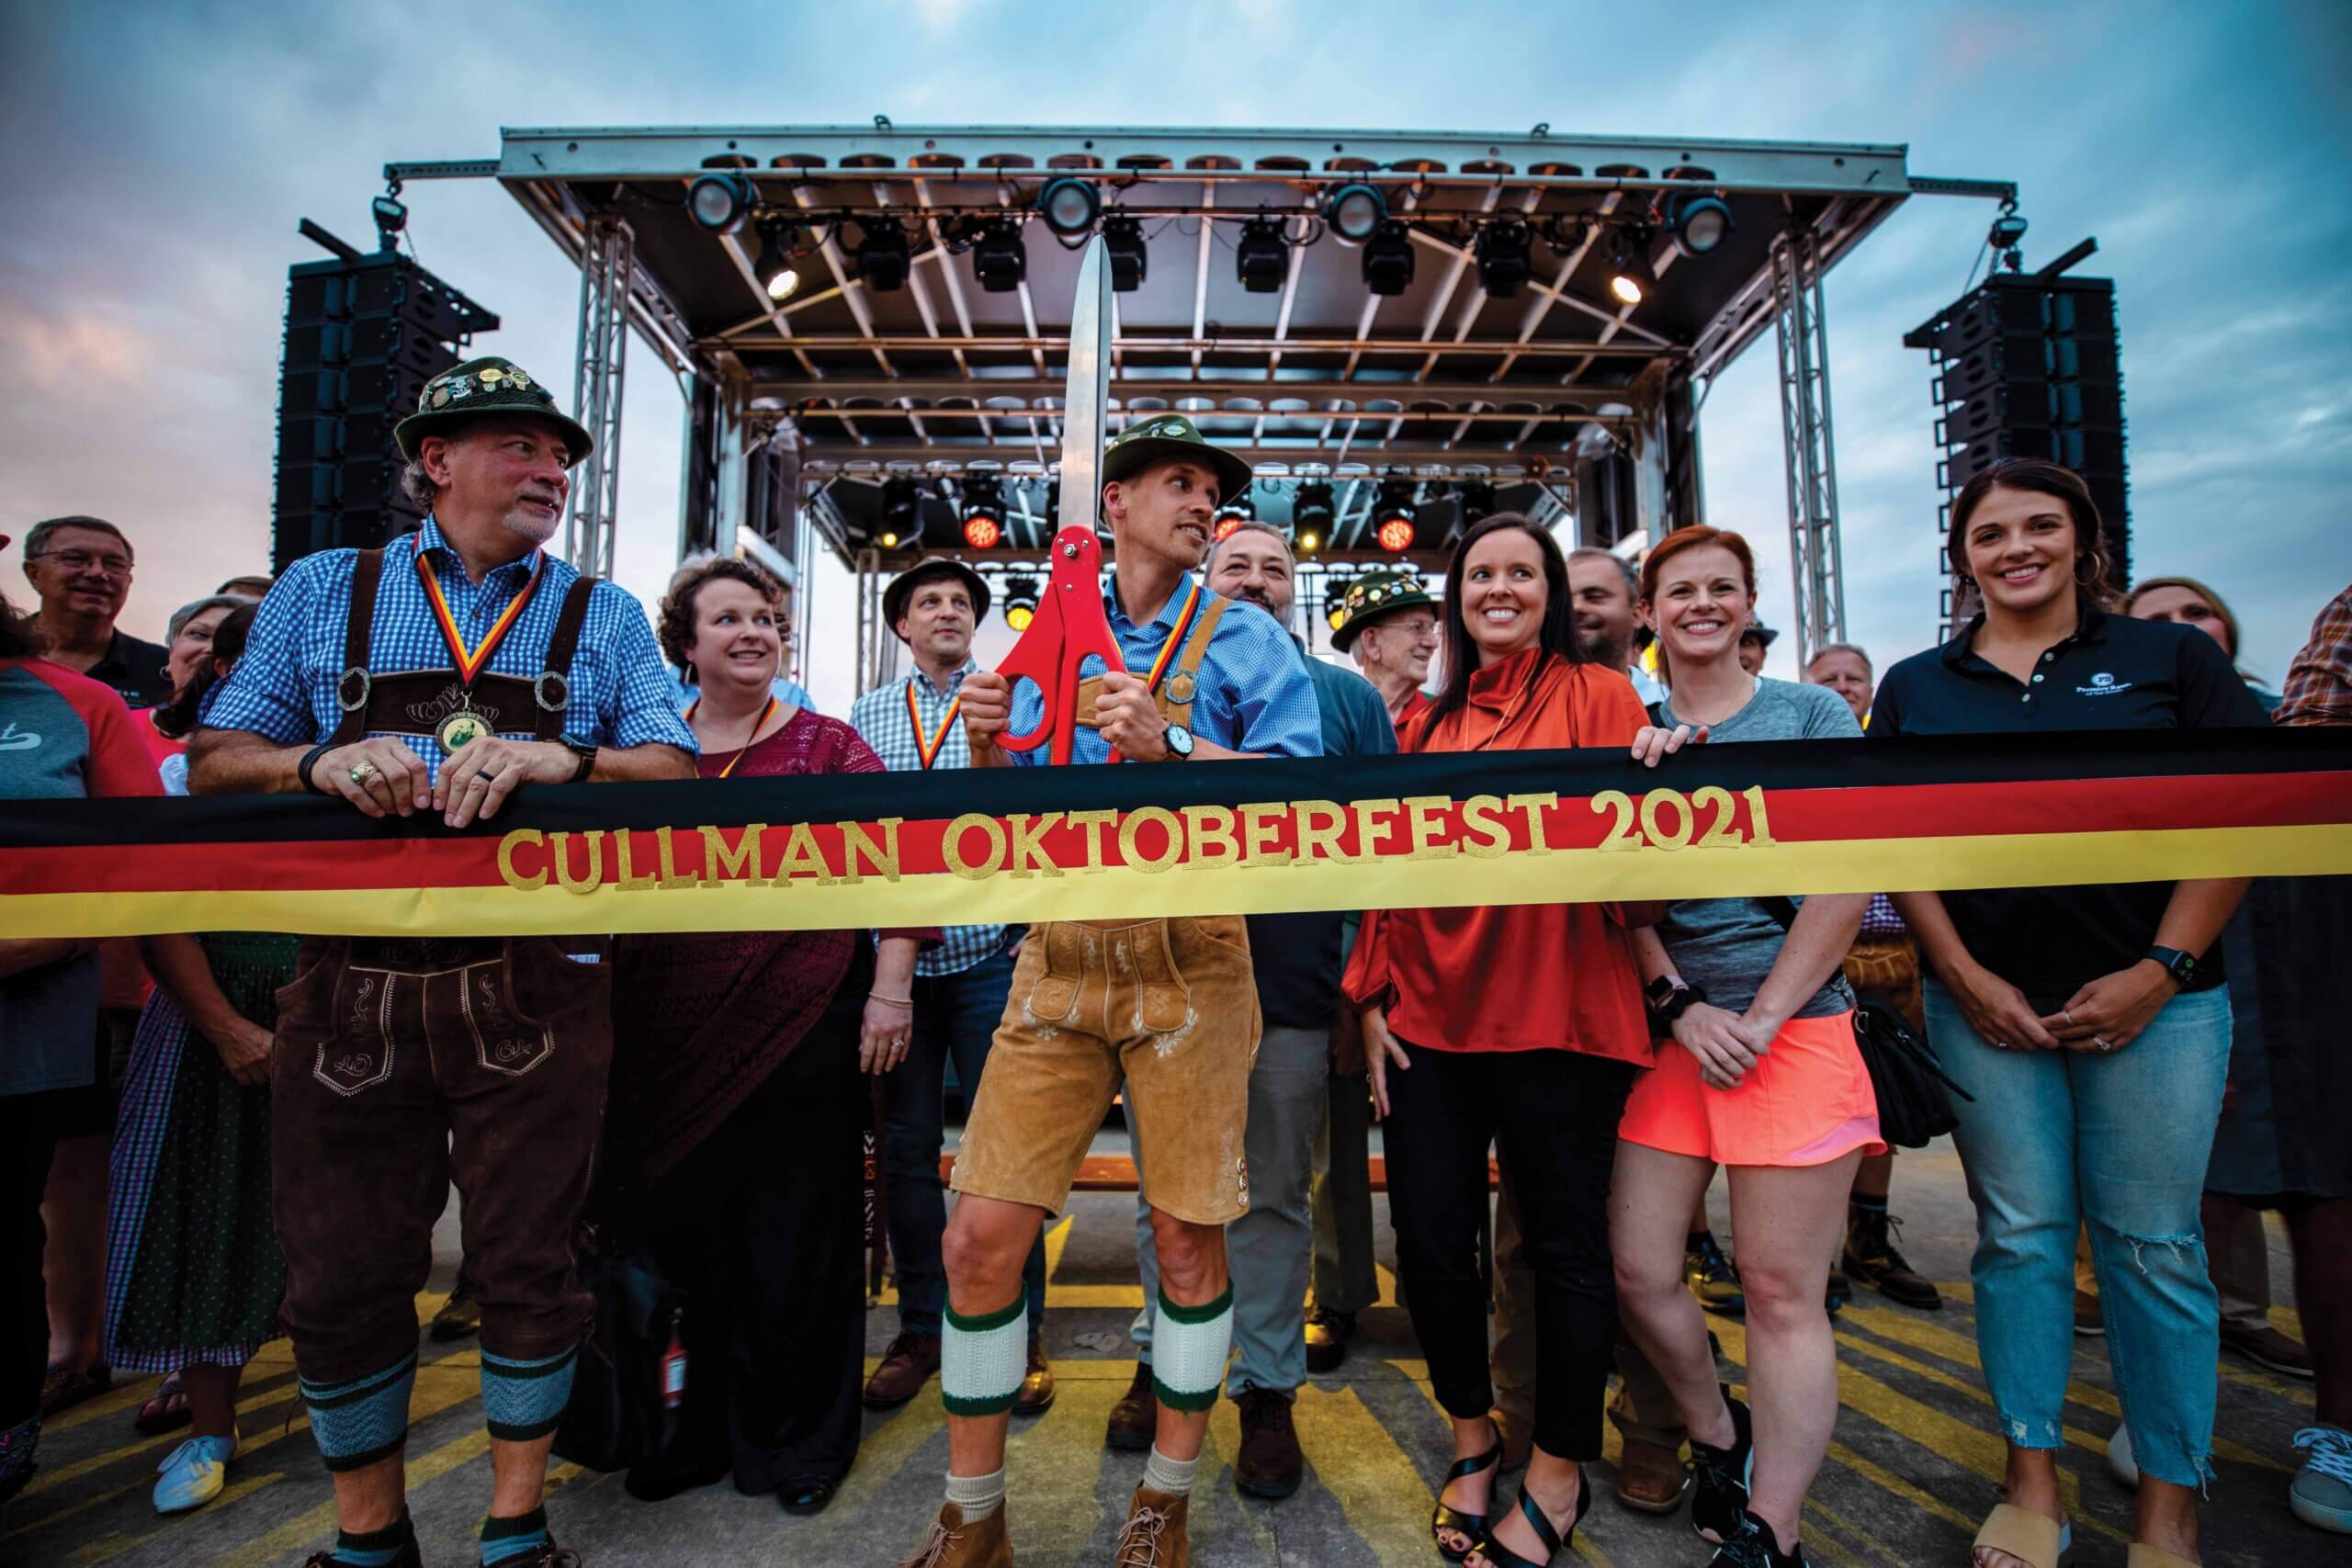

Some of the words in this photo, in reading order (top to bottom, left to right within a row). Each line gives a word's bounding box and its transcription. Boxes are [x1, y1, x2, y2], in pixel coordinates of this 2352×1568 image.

[497, 817, 904, 895] CULLMAN
[942, 792, 1559, 881] OKTOBERFEST
[1590, 784, 1777, 852] 2021
